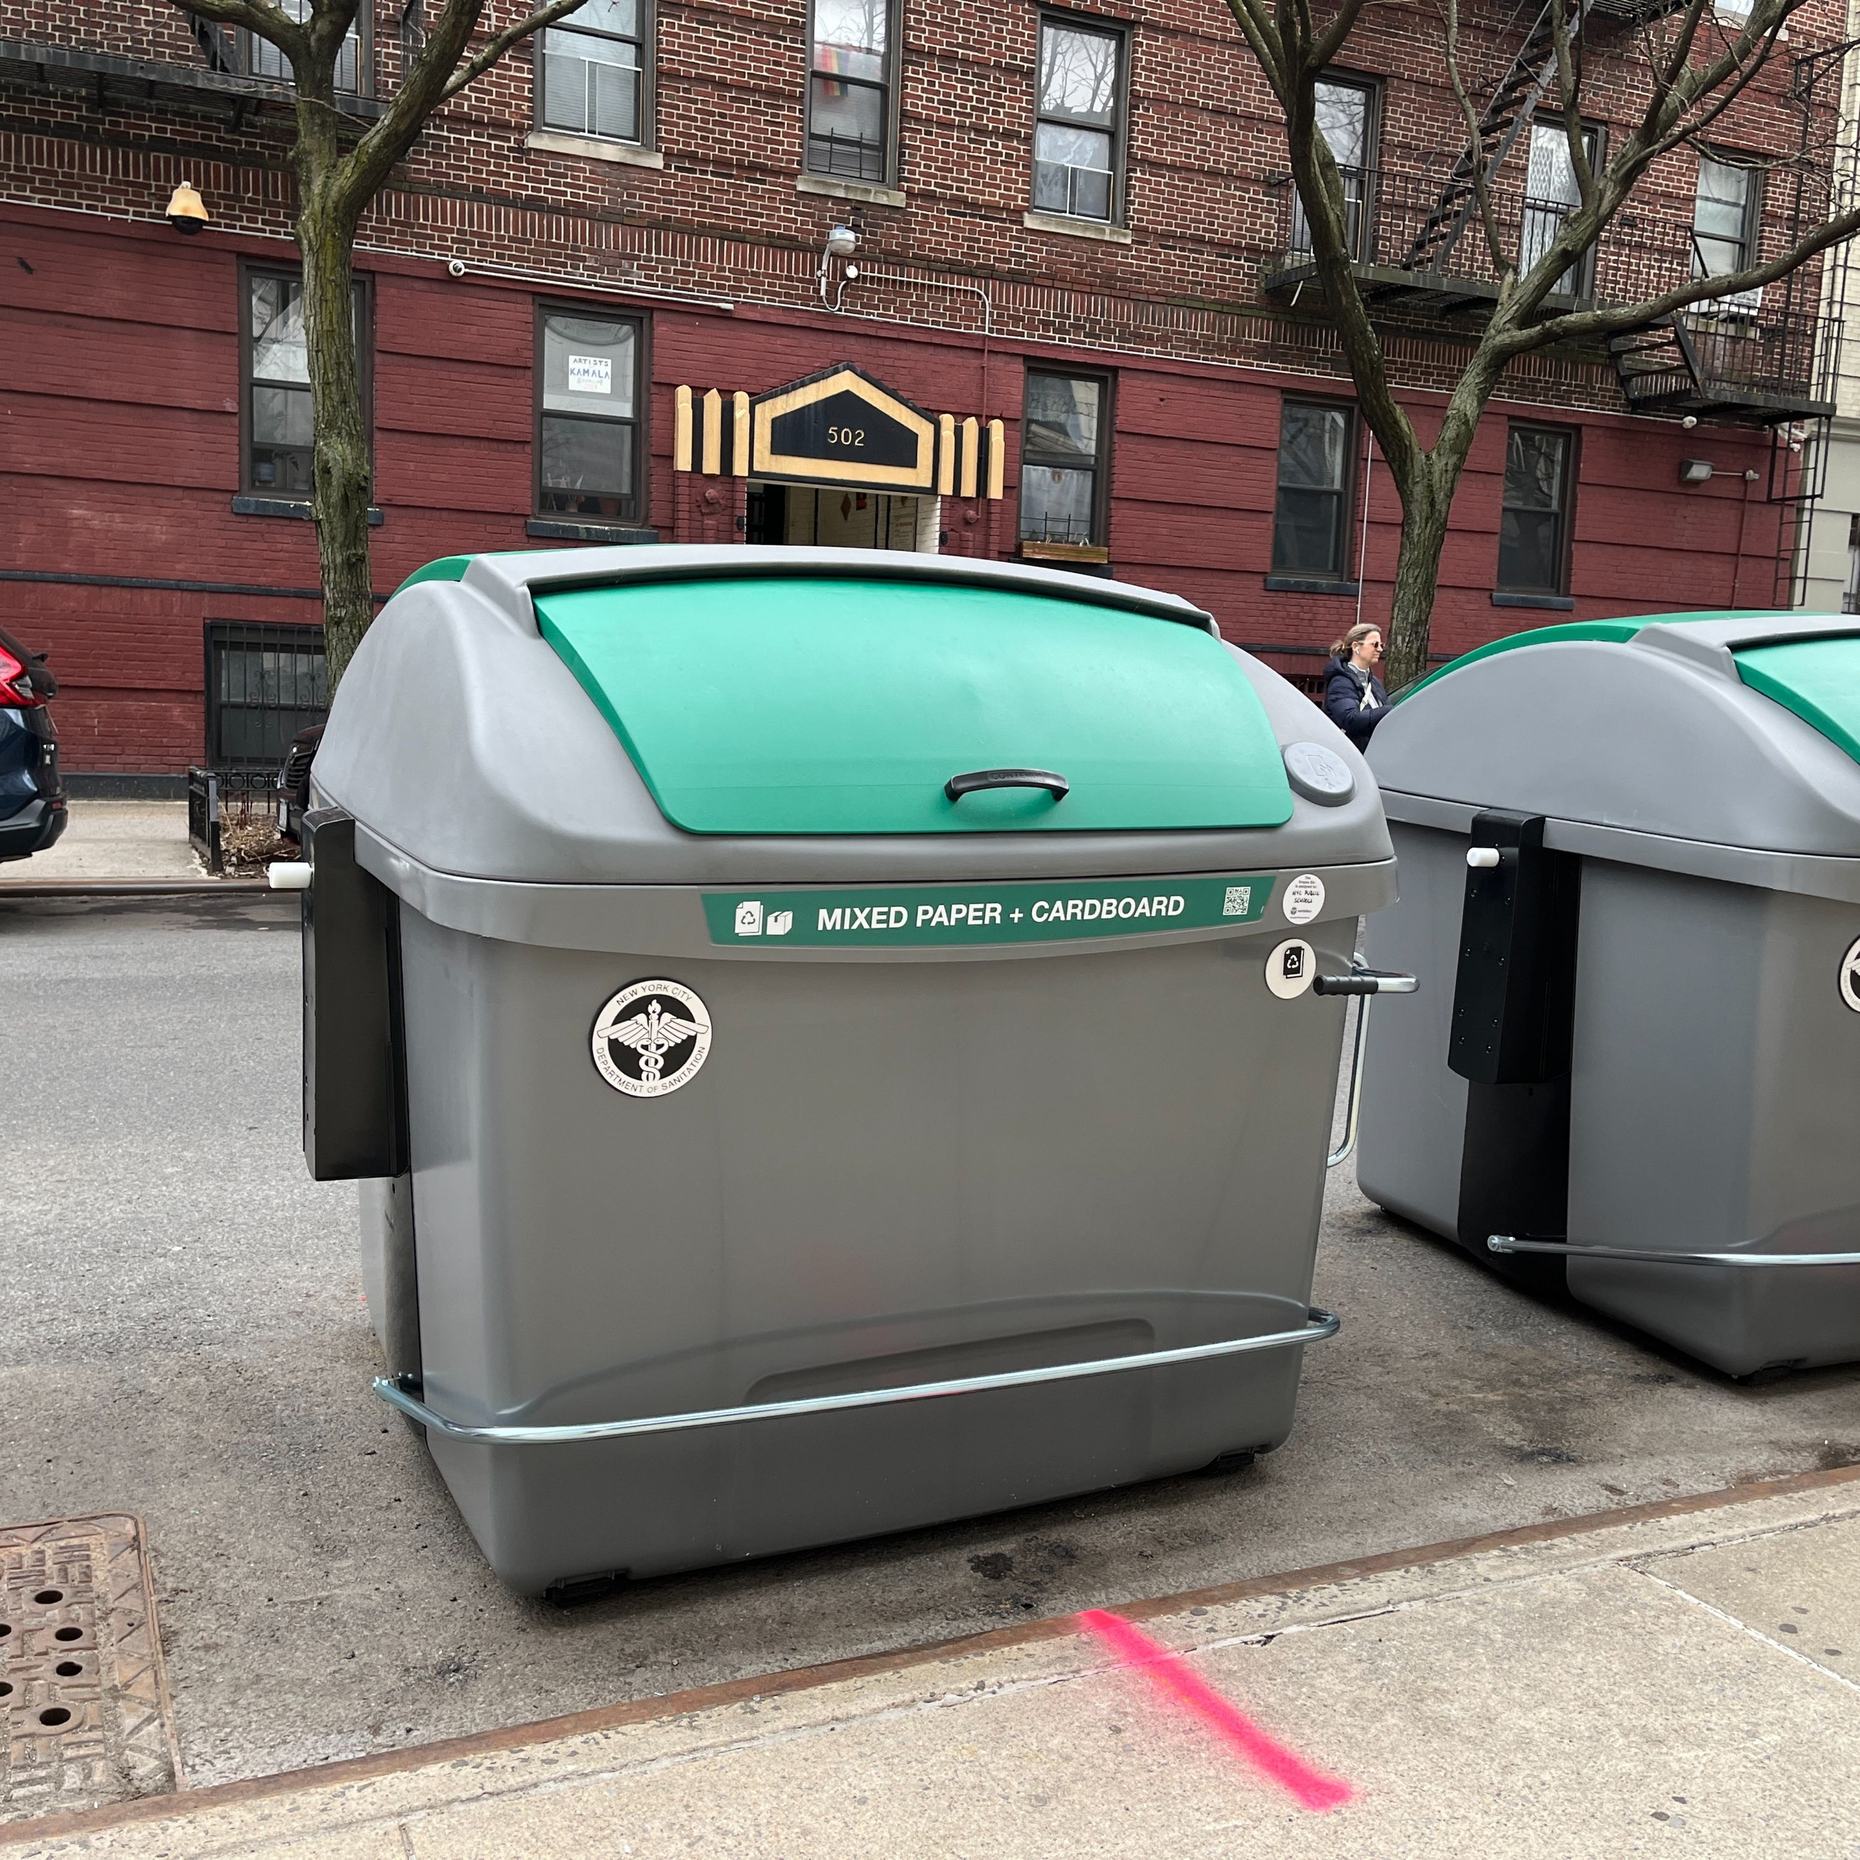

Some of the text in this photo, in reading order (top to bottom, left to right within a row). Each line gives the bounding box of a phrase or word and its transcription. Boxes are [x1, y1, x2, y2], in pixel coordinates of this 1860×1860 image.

[573, 358, 609, 367] ARTISTS
[570, 367, 610, 380] KAMALA
[827, 426, 865, 446] 502
[817, 895, 1185, 931] MIXED PAPER + CARDBOARD
[616, 984, 693, 1006] NEW YORK CITY
[596, 1046, 706, 1094] DEPARTMENT OF SANITATION
